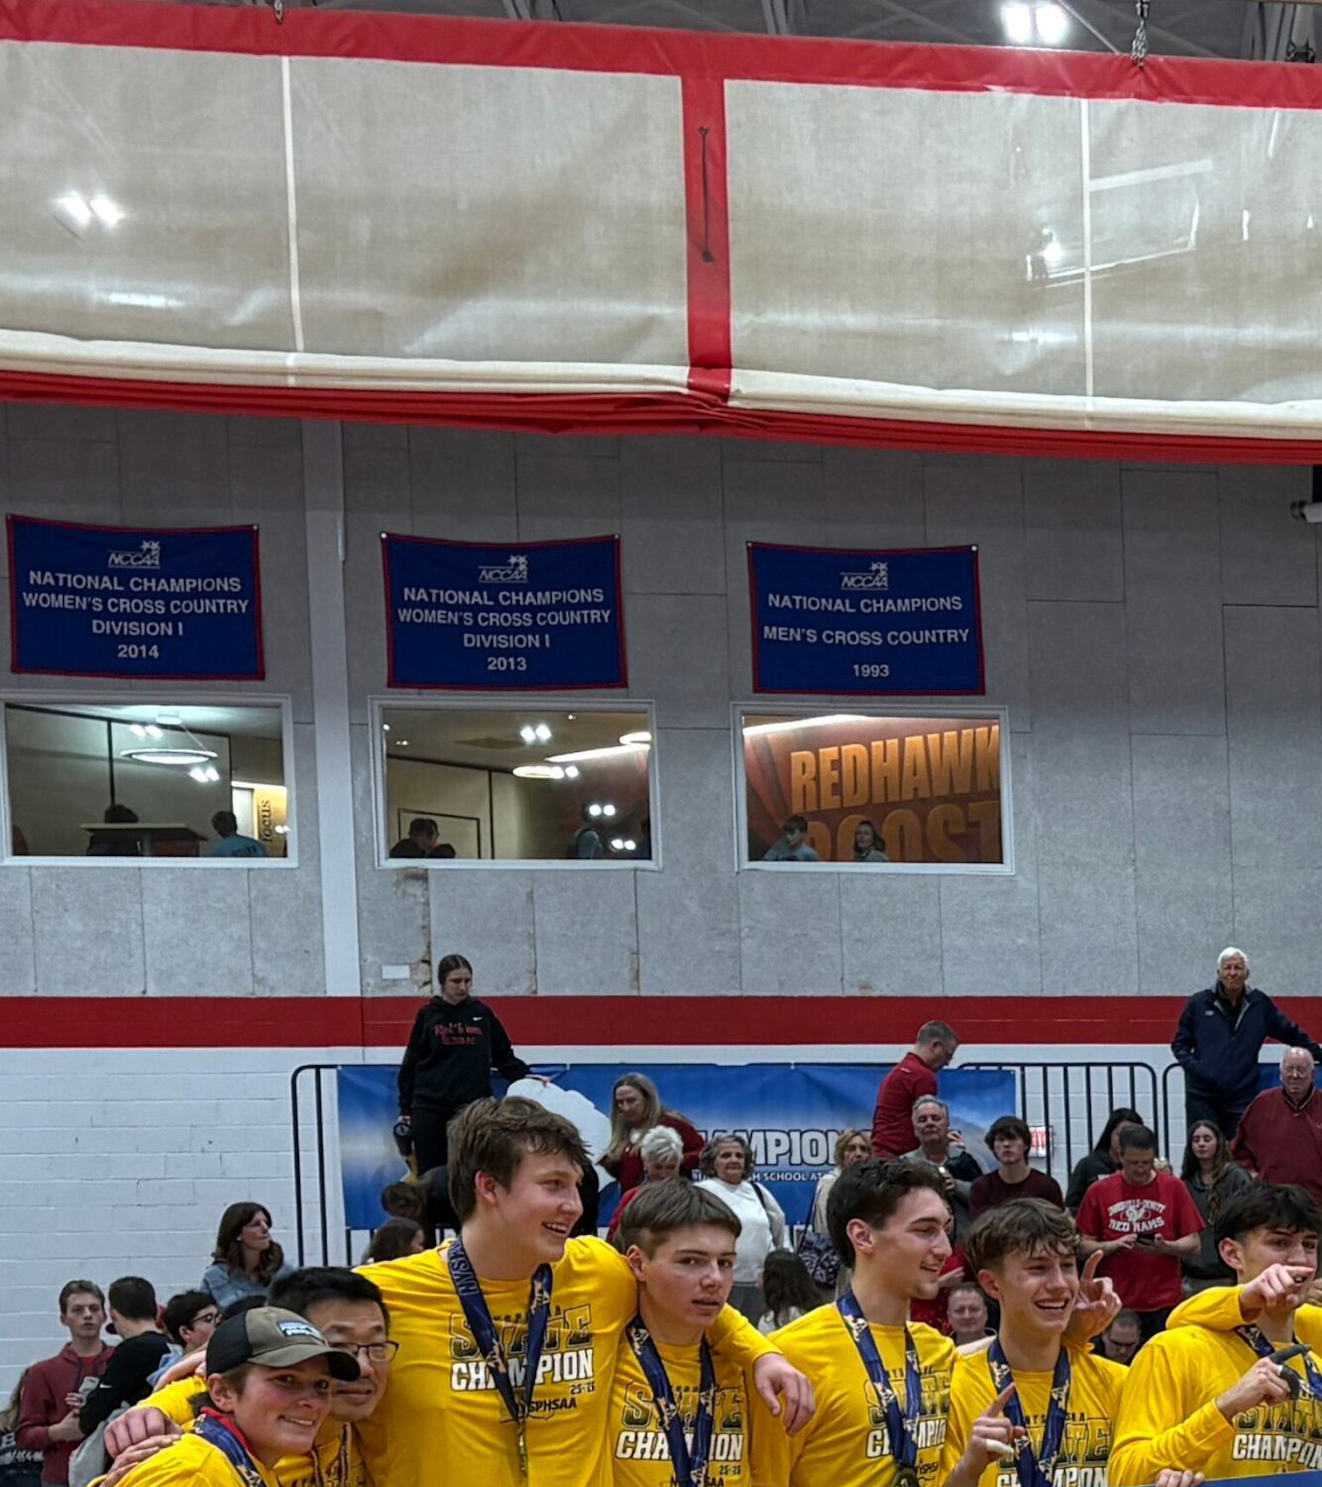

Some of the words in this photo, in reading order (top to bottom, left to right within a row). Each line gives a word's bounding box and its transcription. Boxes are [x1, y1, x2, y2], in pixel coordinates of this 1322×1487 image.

[29, 570, 124, 591] NATIONAL
[129, 577, 241, 592] CHAMPIONS
[22, 591, 103, 611] WOMEN'S
[107, 598, 165, 614] CROSS
[169, 599, 249, 614] COUNTRY
[403, 587, 494, 605] NATIONAL
[498, 588, 604, 606] CHAMPIONS
[768, 593, 856, 613] NATIONAL
[860, 596, 963, 613] CHAMPIONS
[398, 608, 473, 626] WOMEN'S
[478, 611, 533, 627] CROSS
[536, 609, 611, 626] COUNTRY
[92, 619, 173, 636] DIVISION
[178, 622, 183, 636] I
[763, 625, 817, 643] MEN'S
[822, 630, 882, 646] CROSS
[887, 629, 970, 645] COUNTRY
[463, 633, 540, 648] DIVISION
[545, 634, 550, 647] I
[117, 645, 159, 659] 2014
[487, 657, 527, 671] 2013
[853, 664, 890, 677] 1993
[764, 1171, 807, 1182] SCHOOL
